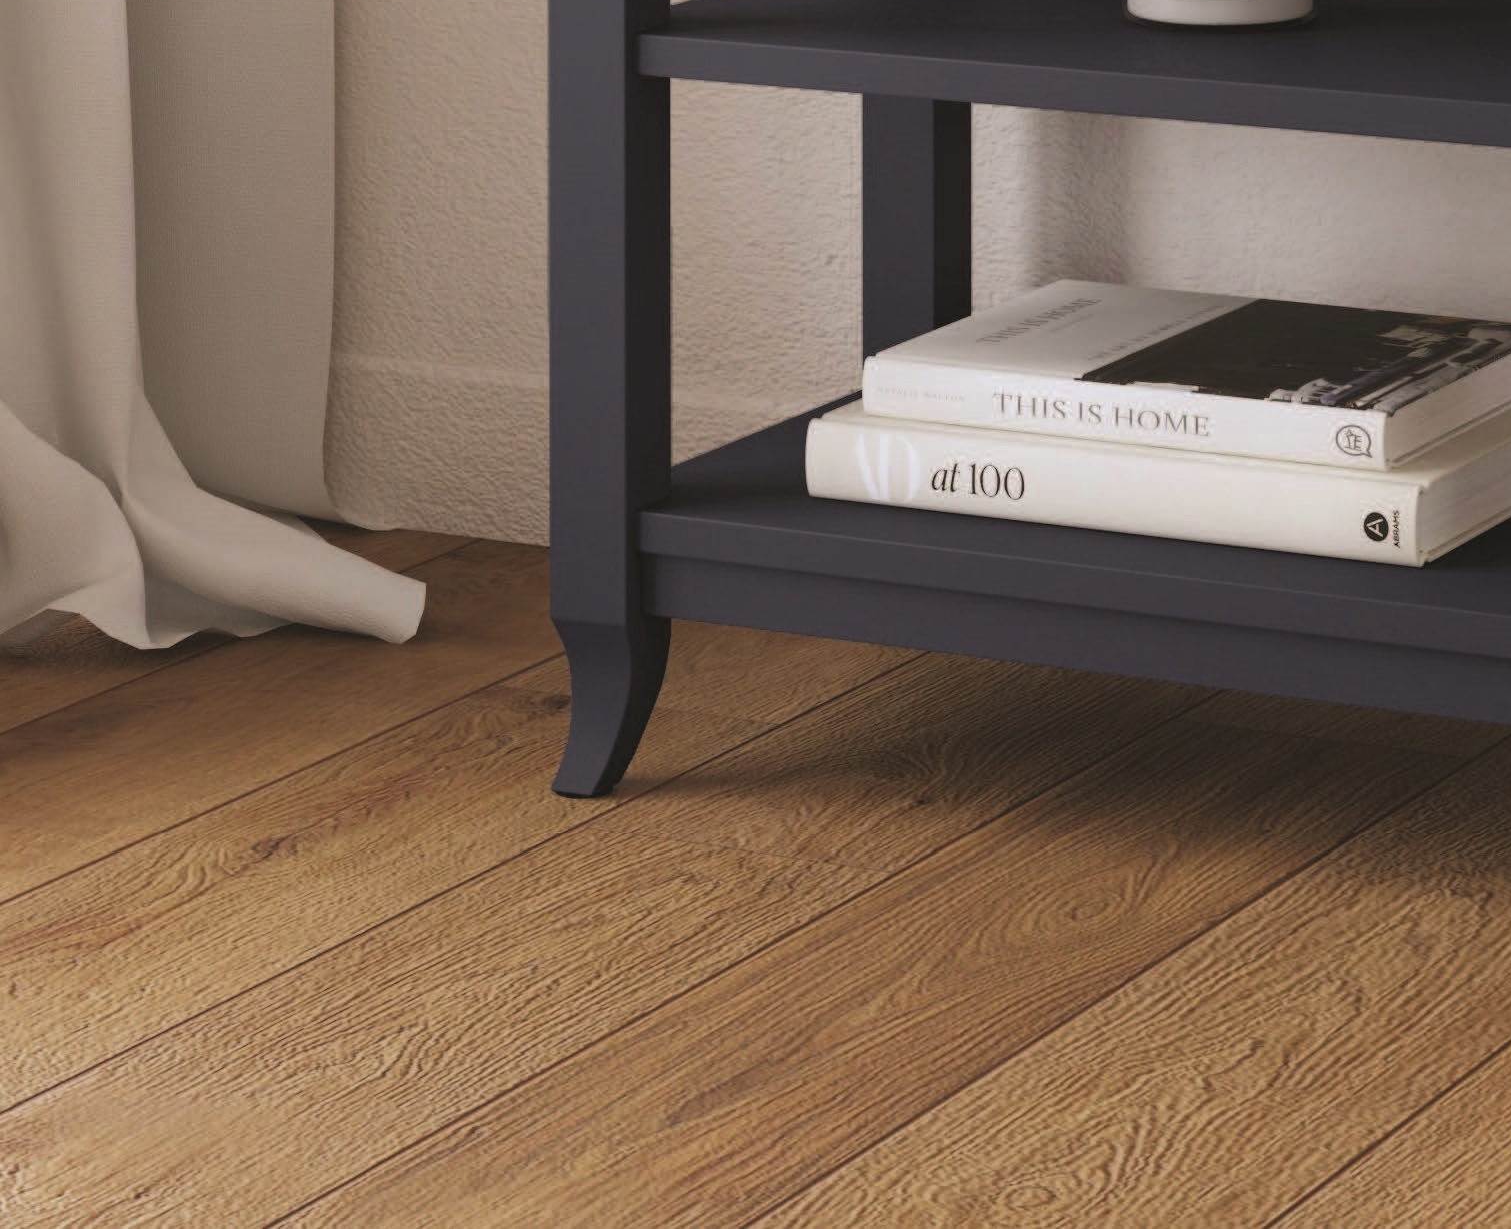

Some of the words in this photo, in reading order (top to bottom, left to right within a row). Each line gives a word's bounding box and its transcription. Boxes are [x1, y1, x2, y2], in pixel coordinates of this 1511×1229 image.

[992, 392, 1068, 420] THIS
[1077, 401, 1103, 424] IS
[1114, 406, 1210, 437] HOME
[931, 462, 961, 493] at
[967, 462, 1026, 501] 100
[1392, 509, 1402, 549] ABRAMS
